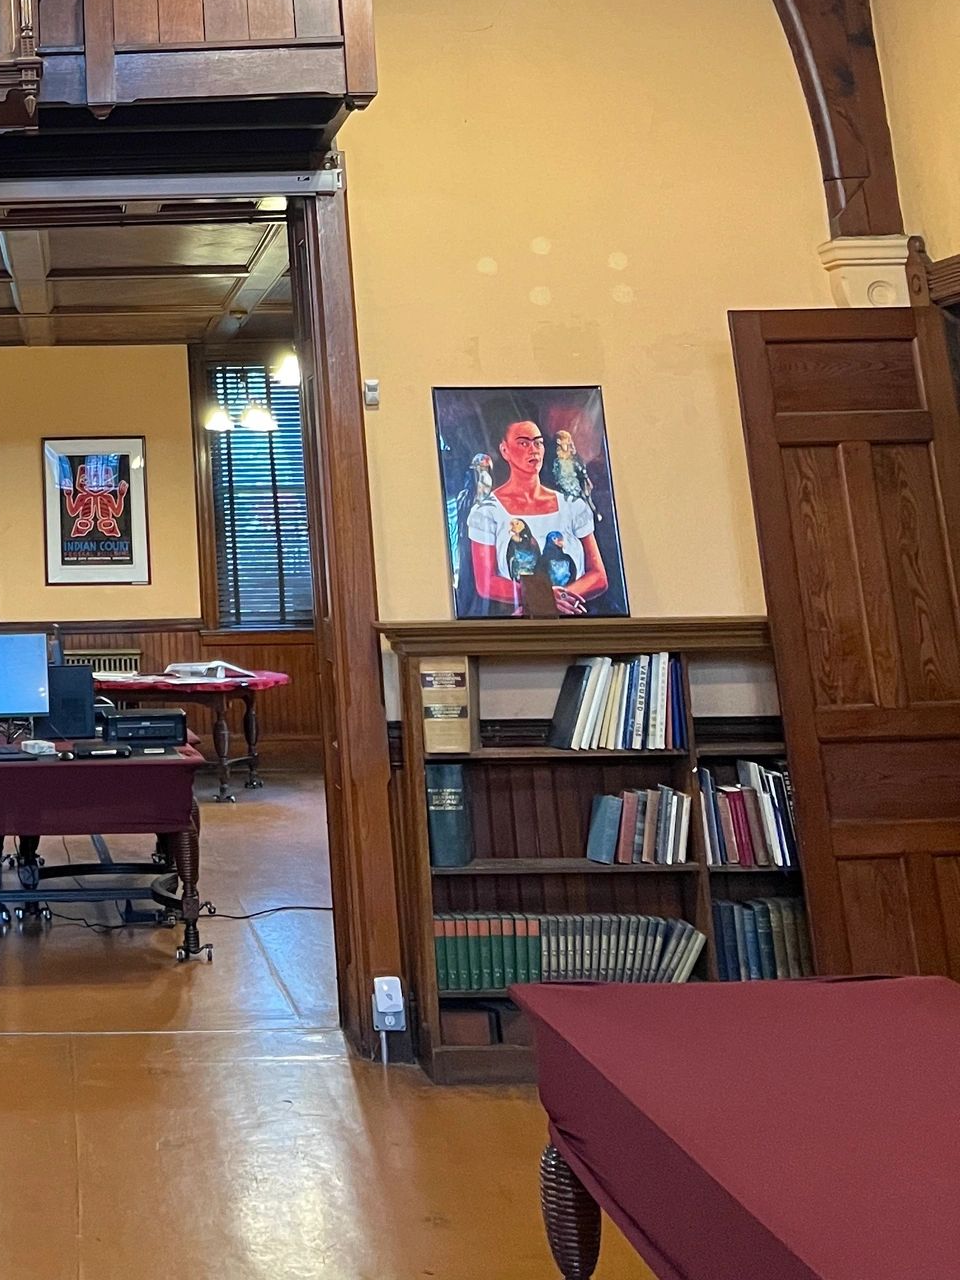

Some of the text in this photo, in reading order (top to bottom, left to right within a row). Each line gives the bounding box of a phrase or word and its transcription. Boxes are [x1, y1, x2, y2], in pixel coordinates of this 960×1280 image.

[64, 541, 129, 551] INDIAN COURT
[637, 665, 647, 712] VANGUARD
